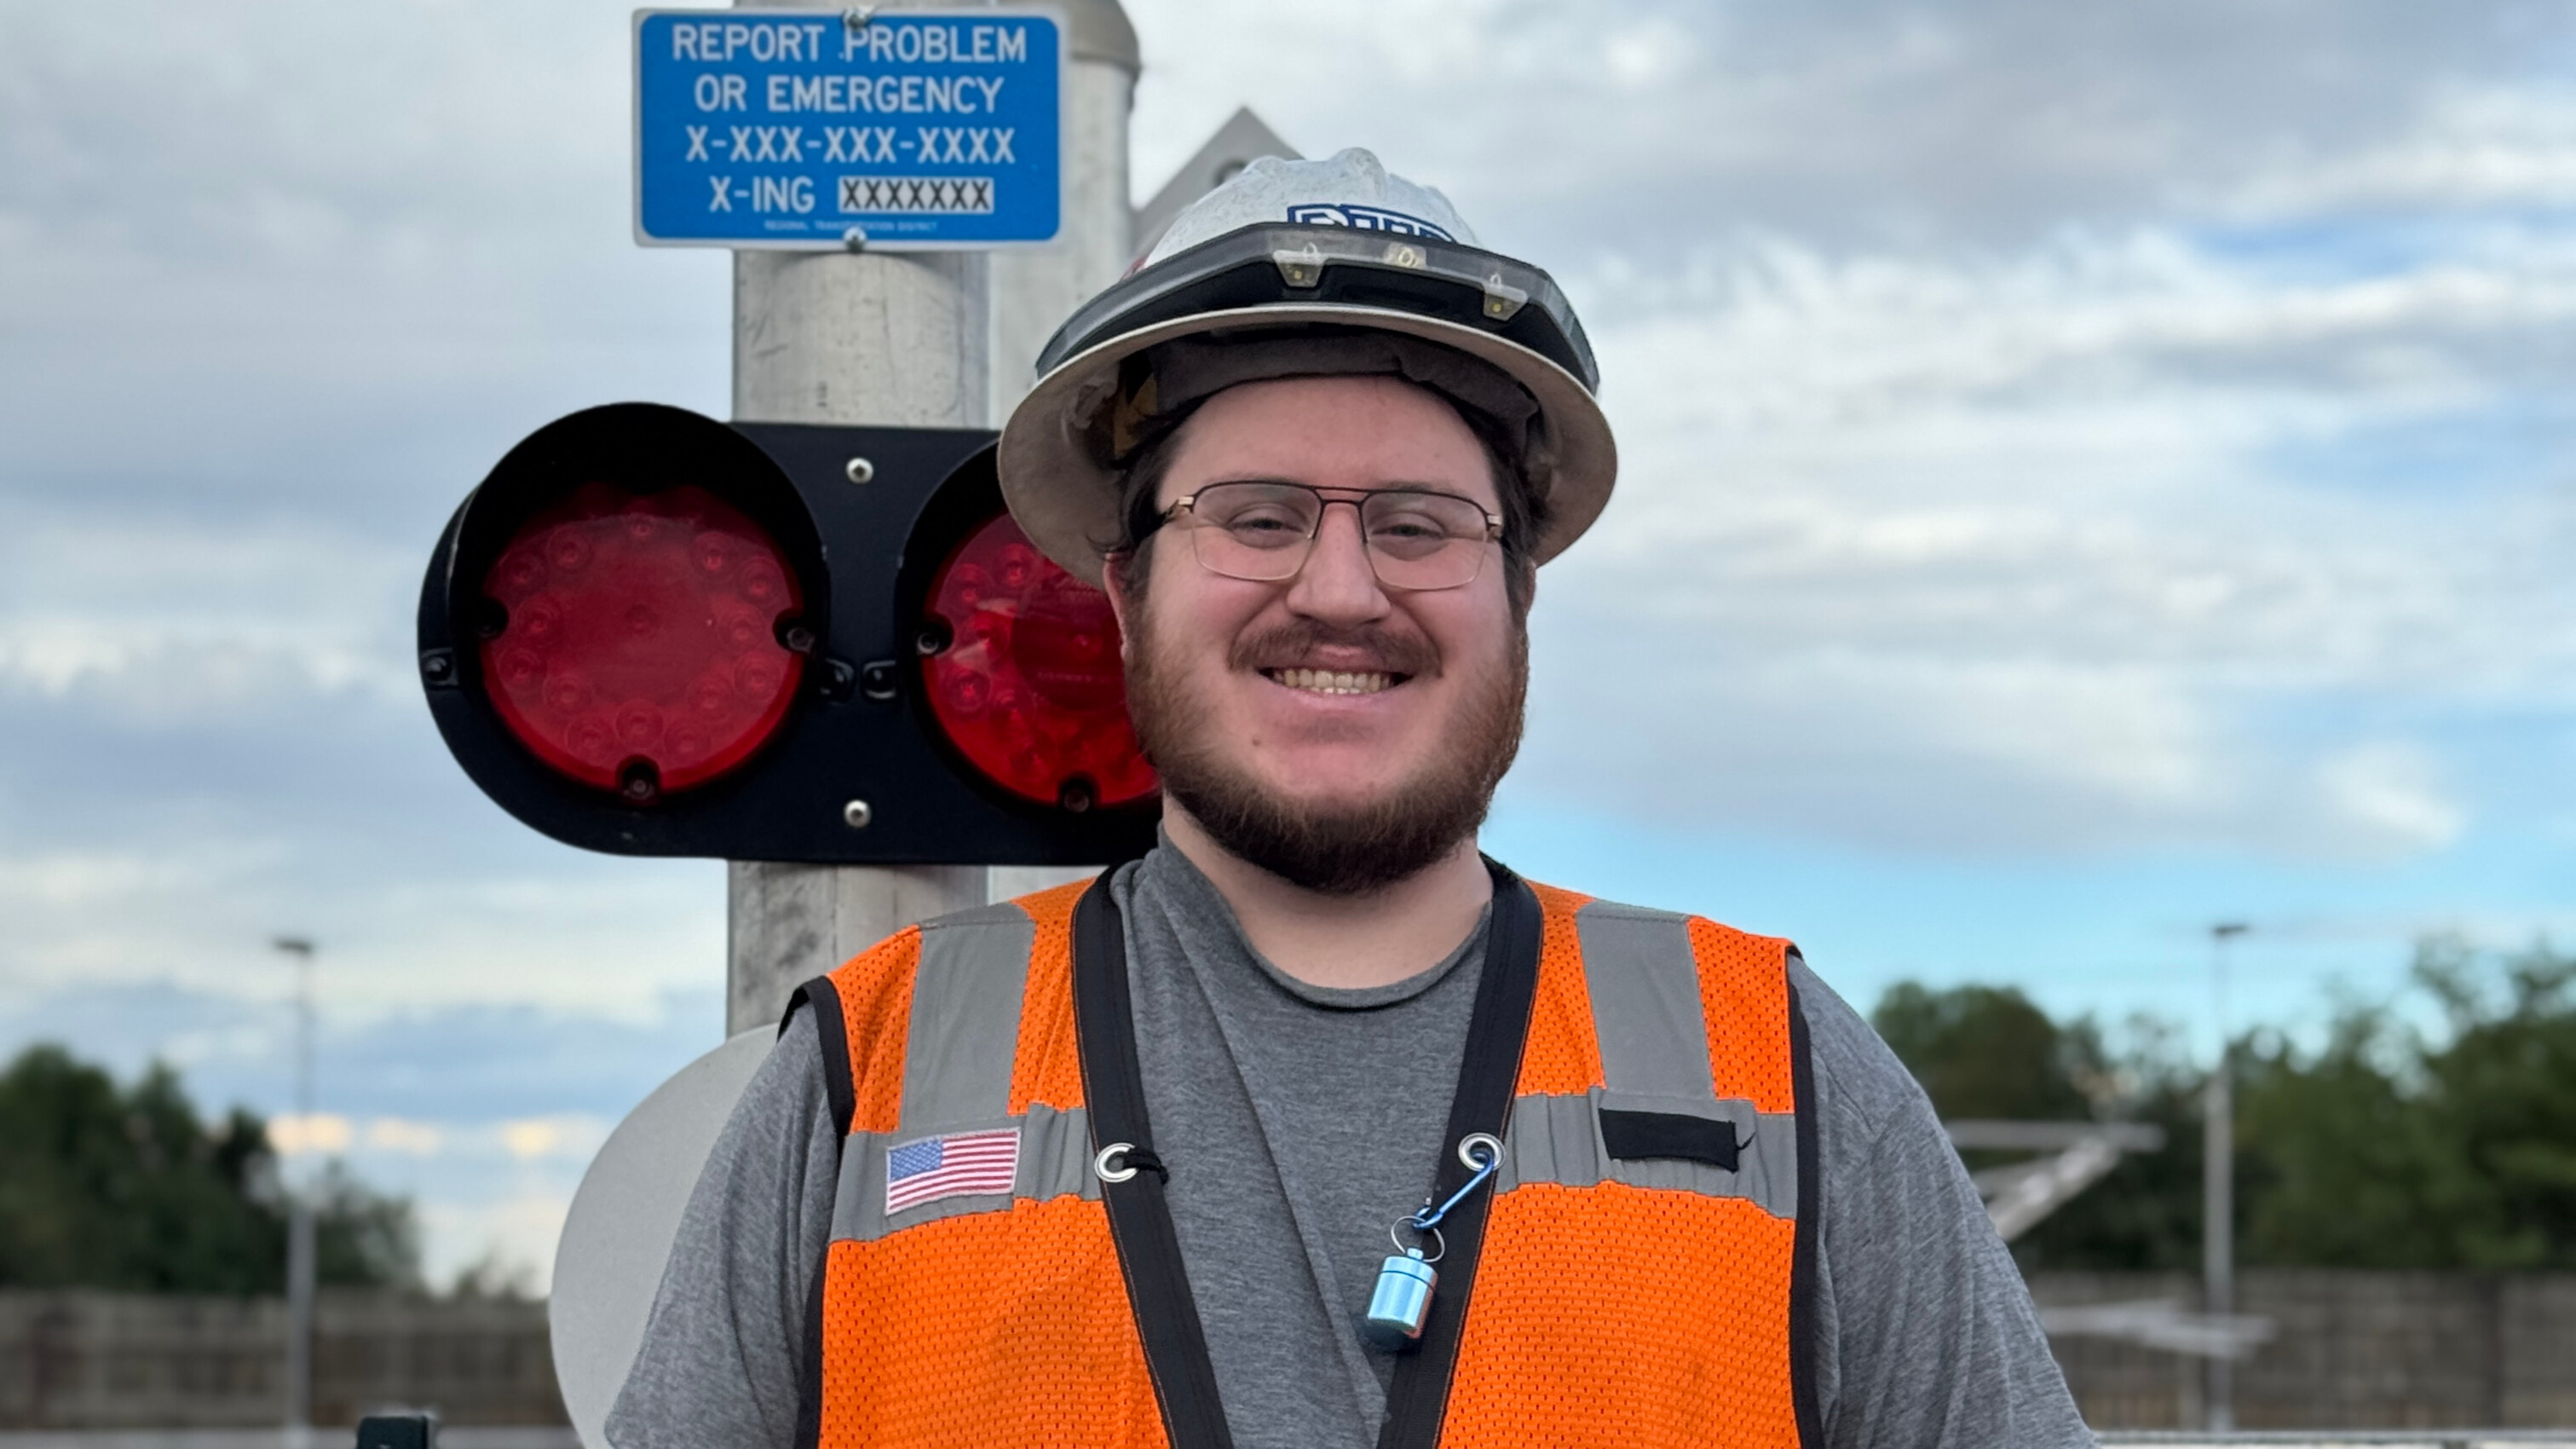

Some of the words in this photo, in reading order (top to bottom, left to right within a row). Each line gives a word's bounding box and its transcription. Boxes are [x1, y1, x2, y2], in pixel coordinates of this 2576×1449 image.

[672, 23, 825, 61] REPORT
[844, 25, 1027, 63] PROBLEM
[694, 72, 746, 113] OR
[768, 74, 1005, 114] EMERGENCY
[685, 125, 1016, 164] X-XXX-XXX-XXXX
[709, 176, 815, 213] X-ING
[843, 179, 989, 211] XXXXXXX
